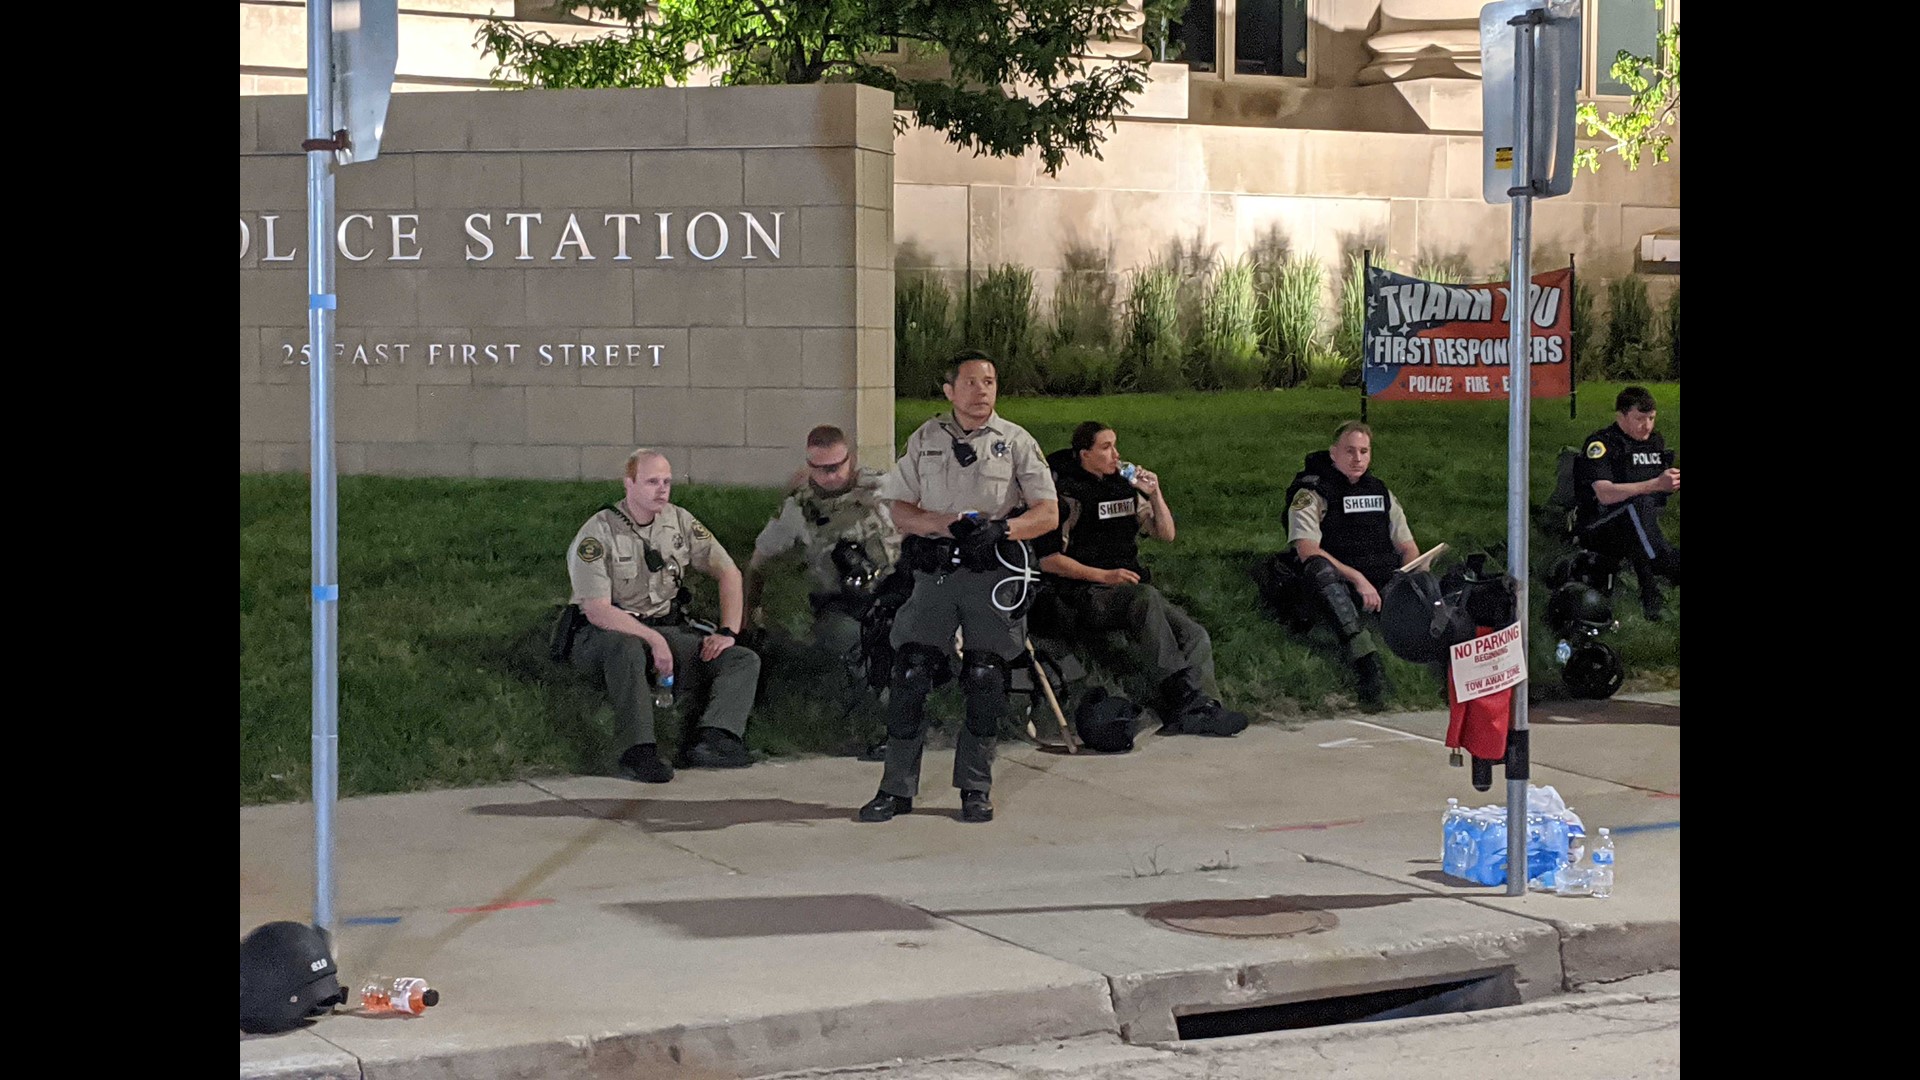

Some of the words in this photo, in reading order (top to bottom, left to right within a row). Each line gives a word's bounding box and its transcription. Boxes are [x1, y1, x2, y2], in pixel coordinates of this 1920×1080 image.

[240, 213, 423, 261] LCE
[465, 211, 785, 261] STATION
[1379, 282, 1492, 327] THANK
[282, 344, 311, 365] 25
[428, 344, 521, 366] FIRST
[538, 344, 666, 367] STREET
[1374, 336, 1431, 365] FIRST
[1434, 335, 1563, 366] RESPONRS
[1409, 376, 1453, 393] POLICE
[1465, 376, 1491, 393] FIRE
[1632, 452, 1662, 465] POLICE
[1345, 497, 1383, 510] SHERIFF
[1454, 643, 1472, 660] NO
[1475, 625, 1519, 654] PARKING
[1465, 681, 1483, 691] TOW
[1485, 673, 1505, 686] AWAY
[1506, 666, 1520, 679] ZONE
